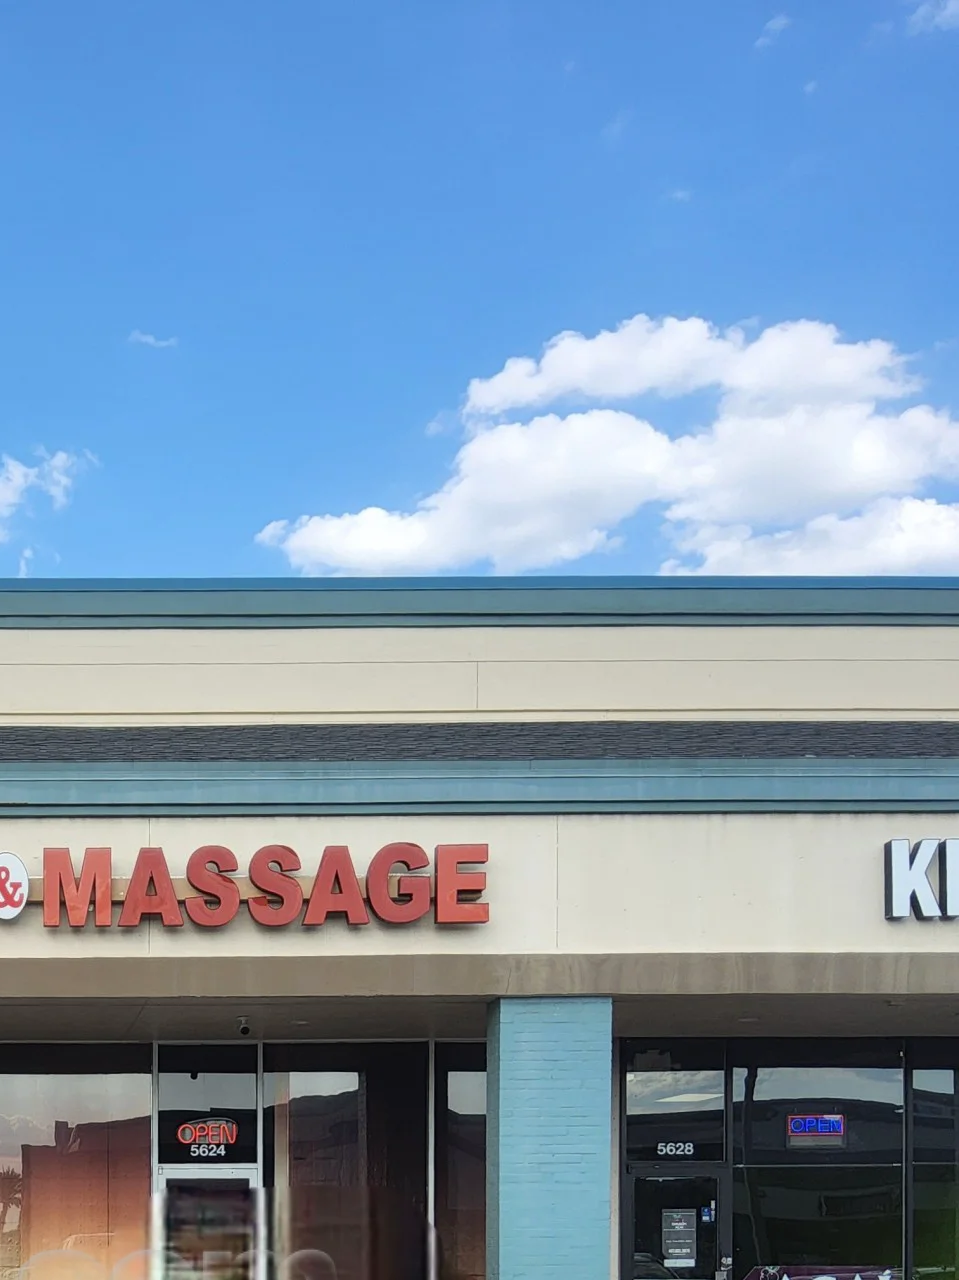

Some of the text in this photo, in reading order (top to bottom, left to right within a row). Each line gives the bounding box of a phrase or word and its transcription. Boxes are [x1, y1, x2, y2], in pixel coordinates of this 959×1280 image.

[43, 842, 489, 928] MASSAGE
[791, 1118, 841, 1132] OPEN
[177, 1123, 237, 1144] OPEN
[190, 1144, 226, 1156] 5624
[657, 1142, 694, 1155] 5628
